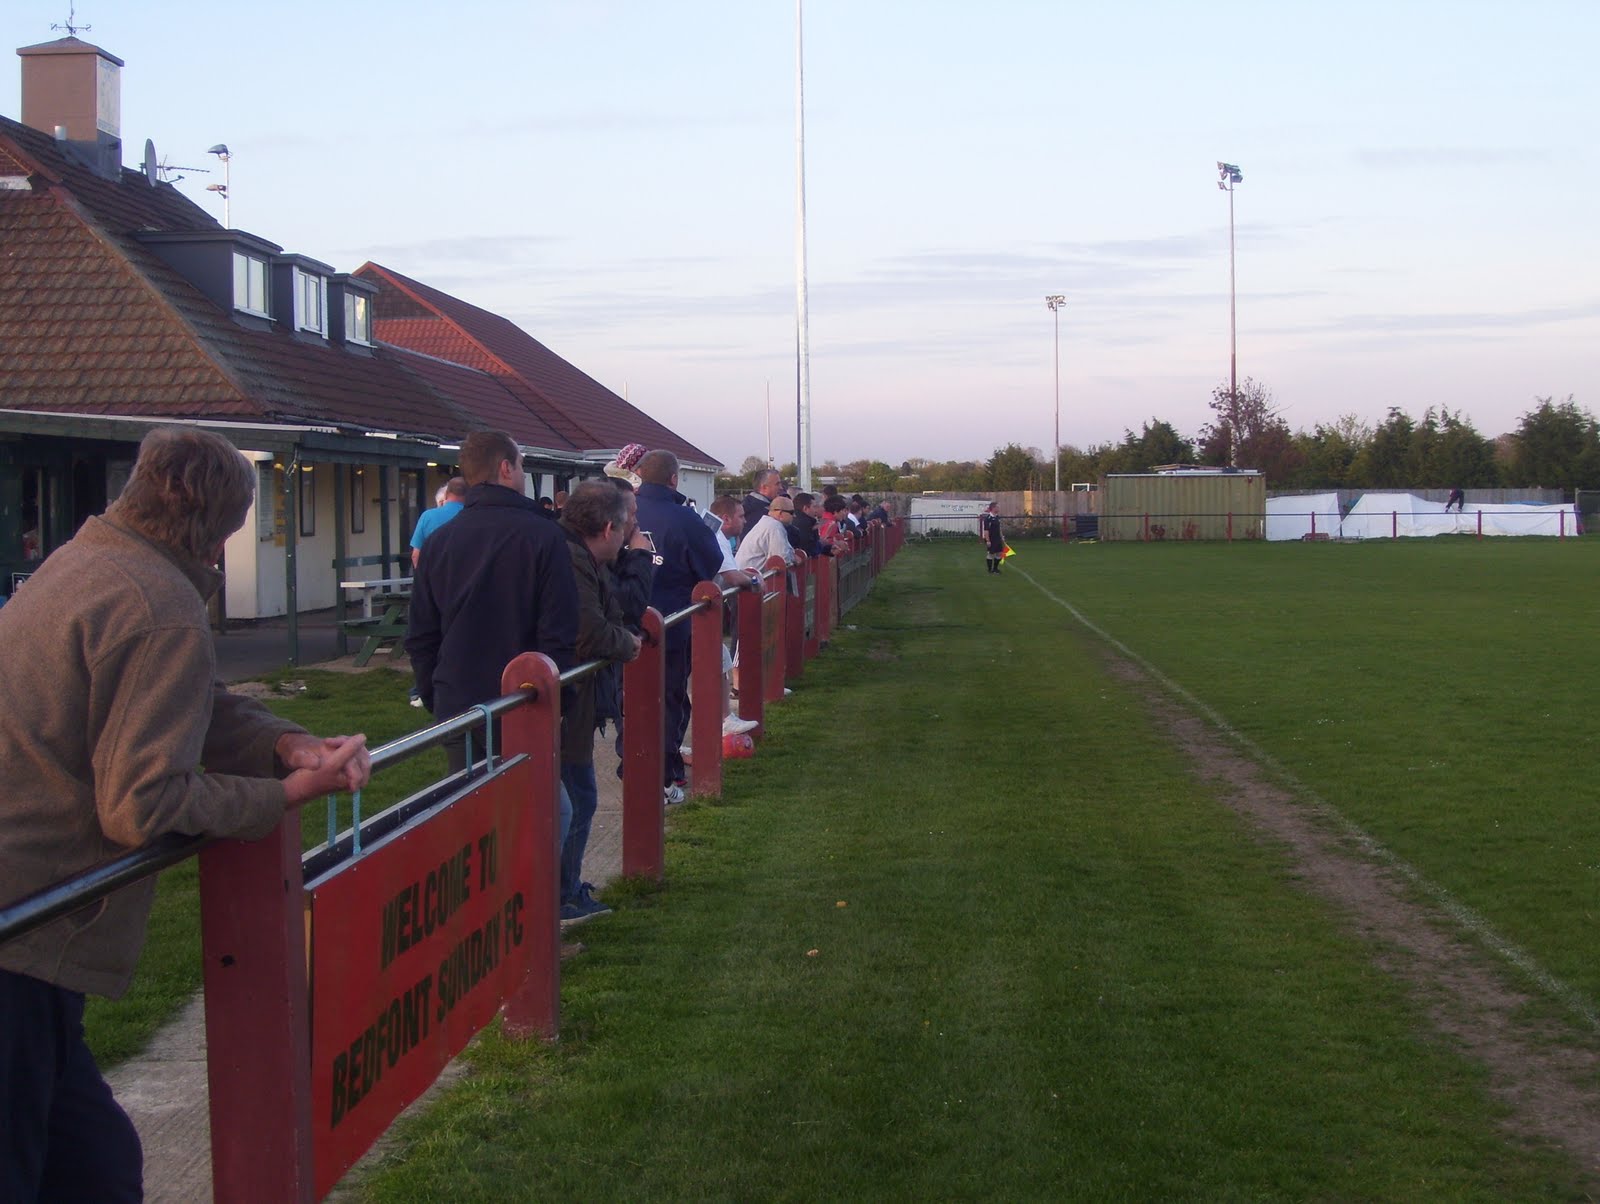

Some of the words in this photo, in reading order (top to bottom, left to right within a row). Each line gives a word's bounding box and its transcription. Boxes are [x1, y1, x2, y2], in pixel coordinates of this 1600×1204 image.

[380, 842, 472, 972] WELCOME
[478, 827, 497, 891] TO
[331, 973, 433, 1131] BEDFONT
[437, 911, 501, 1023] SUNDAY
[504, 892, 524, 956] FC
